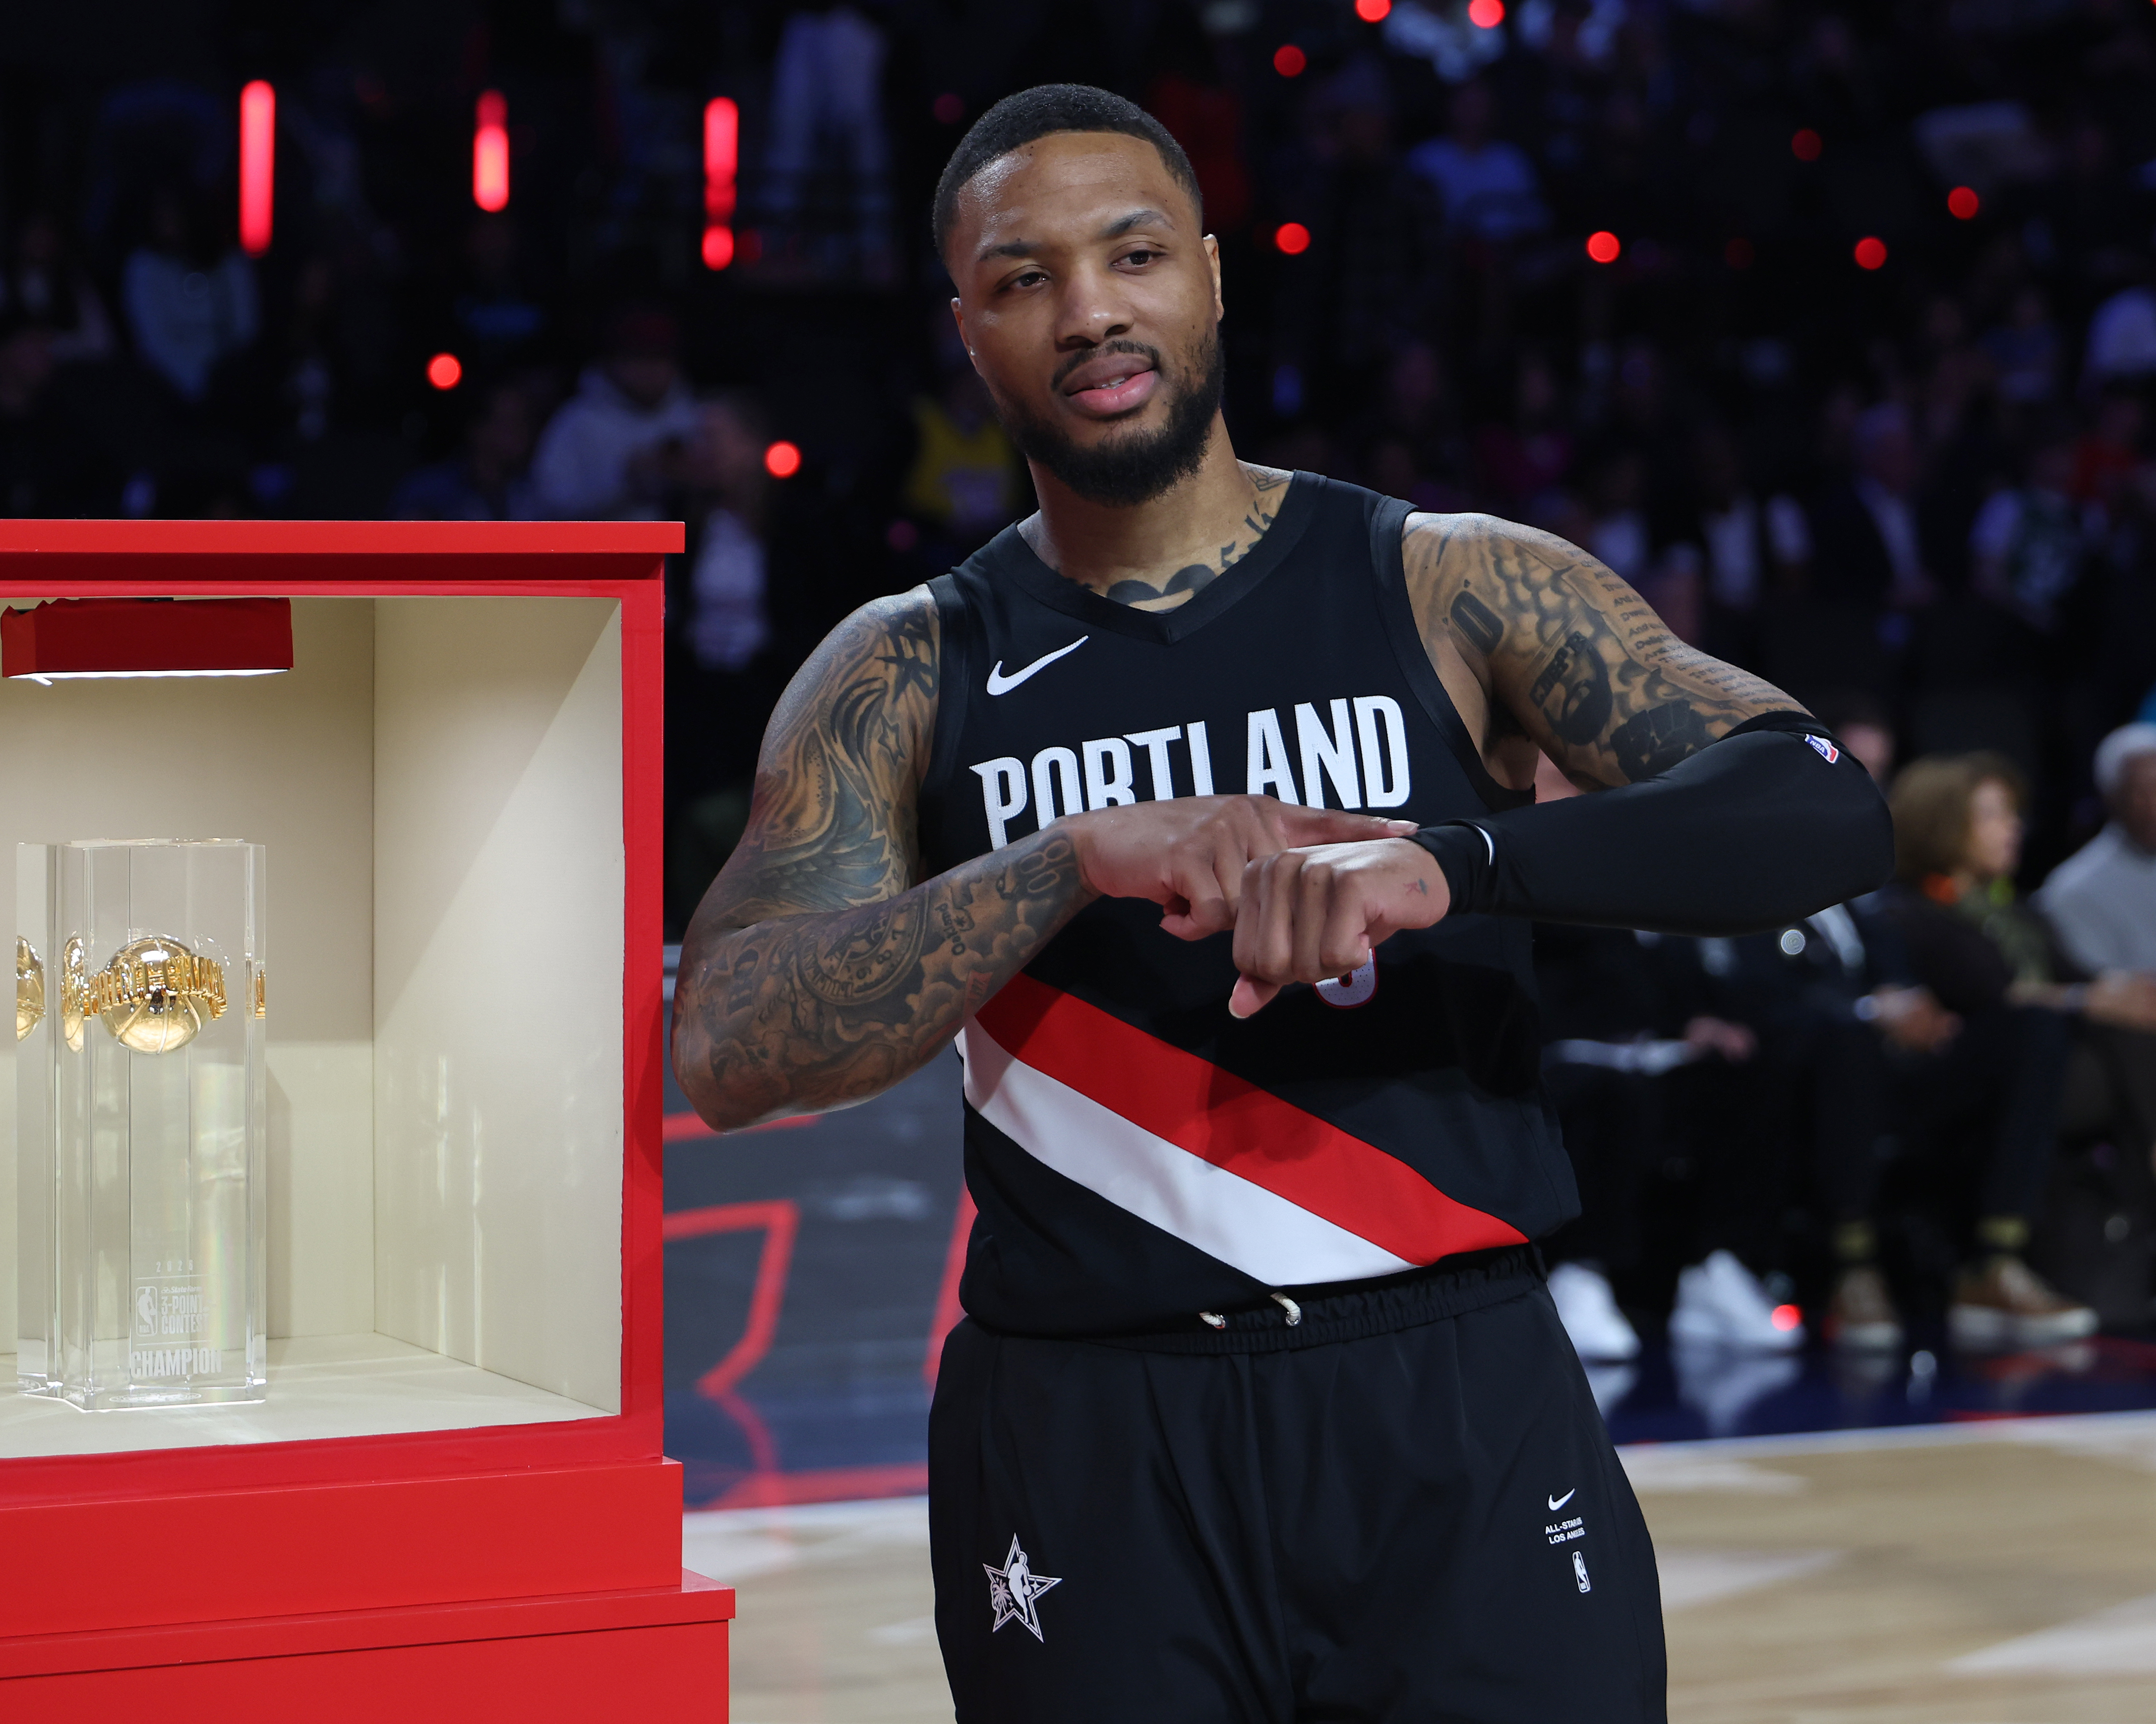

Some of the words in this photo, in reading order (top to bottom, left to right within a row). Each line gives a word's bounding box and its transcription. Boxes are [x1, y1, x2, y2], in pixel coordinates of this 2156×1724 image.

[1809, 740, 1825, 753] NBA
[969, 695, 1411, 851] PORTLAND
[156, 1259, 194, 1273] 2026
[161, 1295, 203, 1315] 3-POINT
[161, 1313, 209, 1335] CONTEST
[130, 1347, 222, 1379] CHAMPION
[1548, 1533, 1566, 1545] LOS
